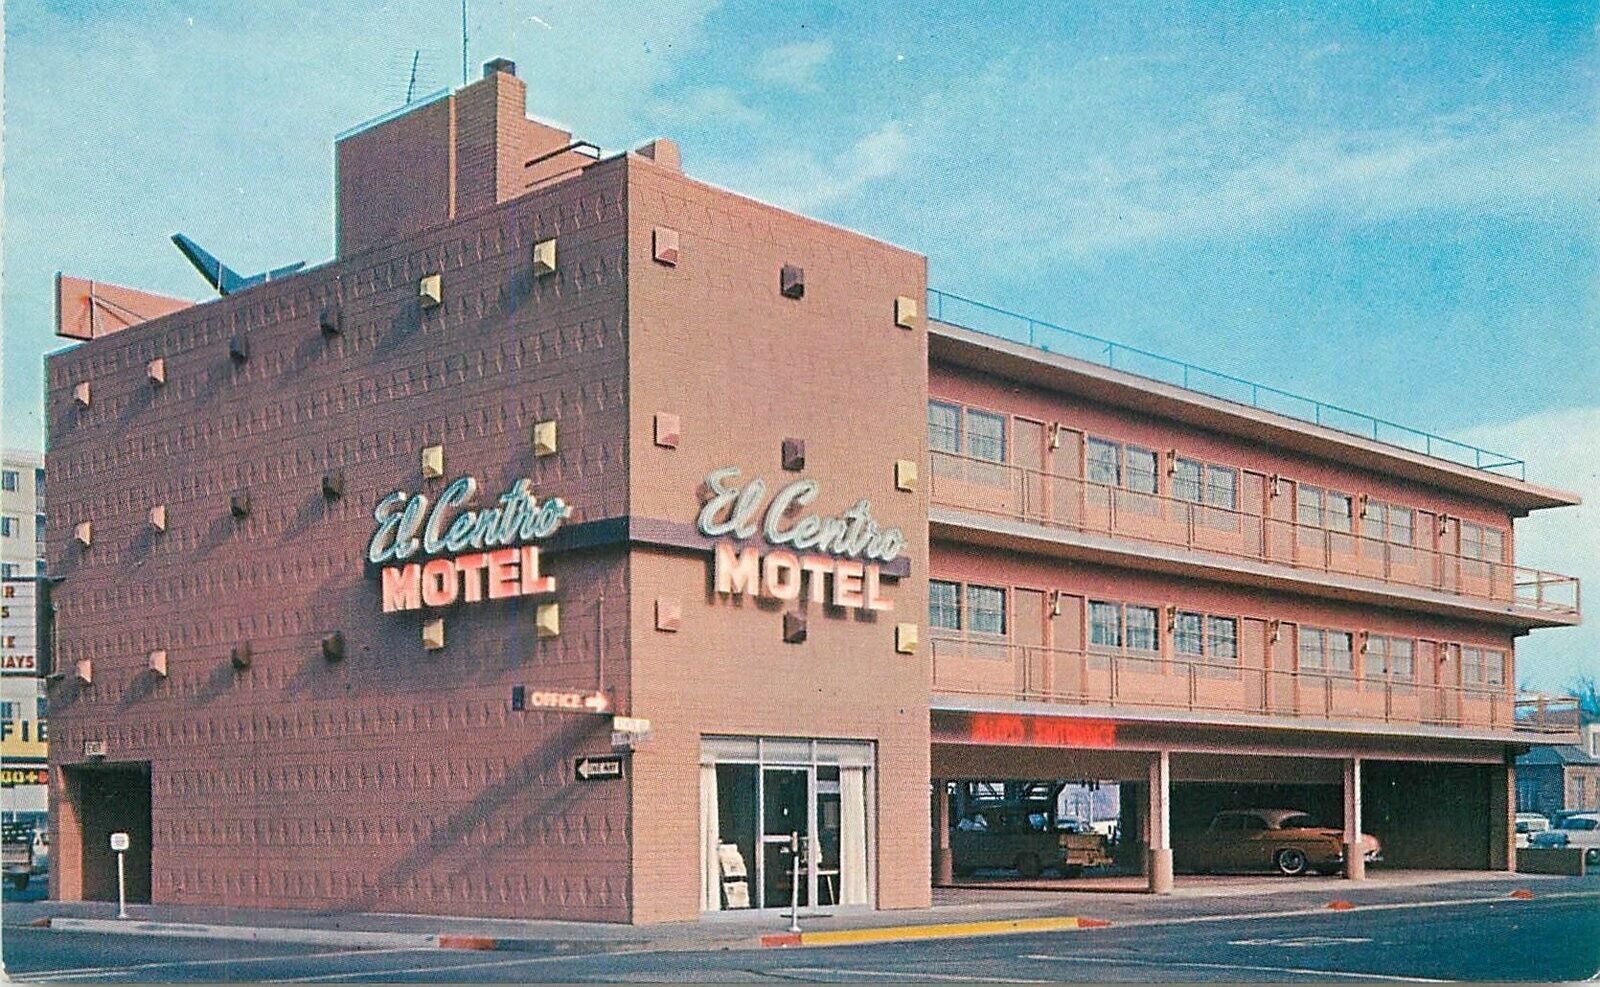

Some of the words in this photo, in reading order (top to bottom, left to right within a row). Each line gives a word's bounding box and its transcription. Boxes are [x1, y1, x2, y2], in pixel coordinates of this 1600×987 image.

[369, 491, 428, 564] El
[424, 476, 573, 554] Centro
[697, 466, 766, 539] El
[764, 478, 908, 561] Centro
[381, 546, 556, 614] MOTEL
[713, 542, 895, 612] MOTEL
[531, 691, 584, 708] OFFICE
